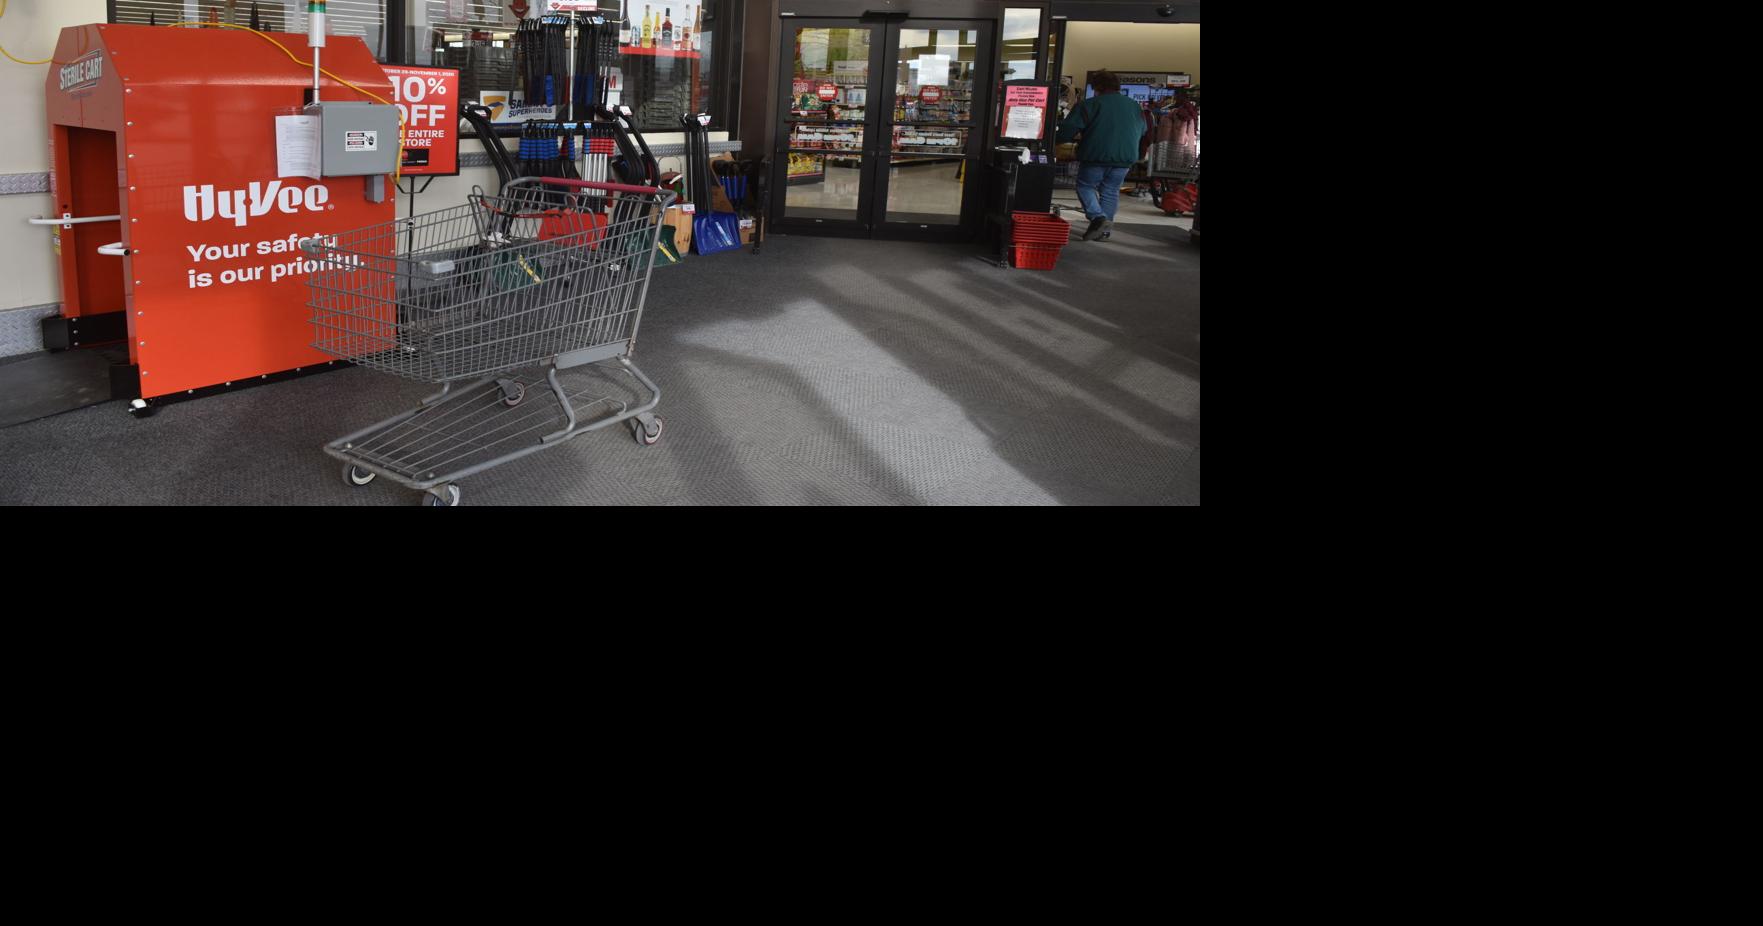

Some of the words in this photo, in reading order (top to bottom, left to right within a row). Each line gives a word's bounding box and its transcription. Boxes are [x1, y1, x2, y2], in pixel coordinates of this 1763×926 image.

[60, 63, 84, 90] STERILE
[85, 57, 103, 80] CART
[388, 75, 447, 103] 10%
[408, 129, 445, 138] ENTIRE
[186, 242, 250, 262] Your
[188, 269, 213, 288] is
[219, 265, 264, 284] our
